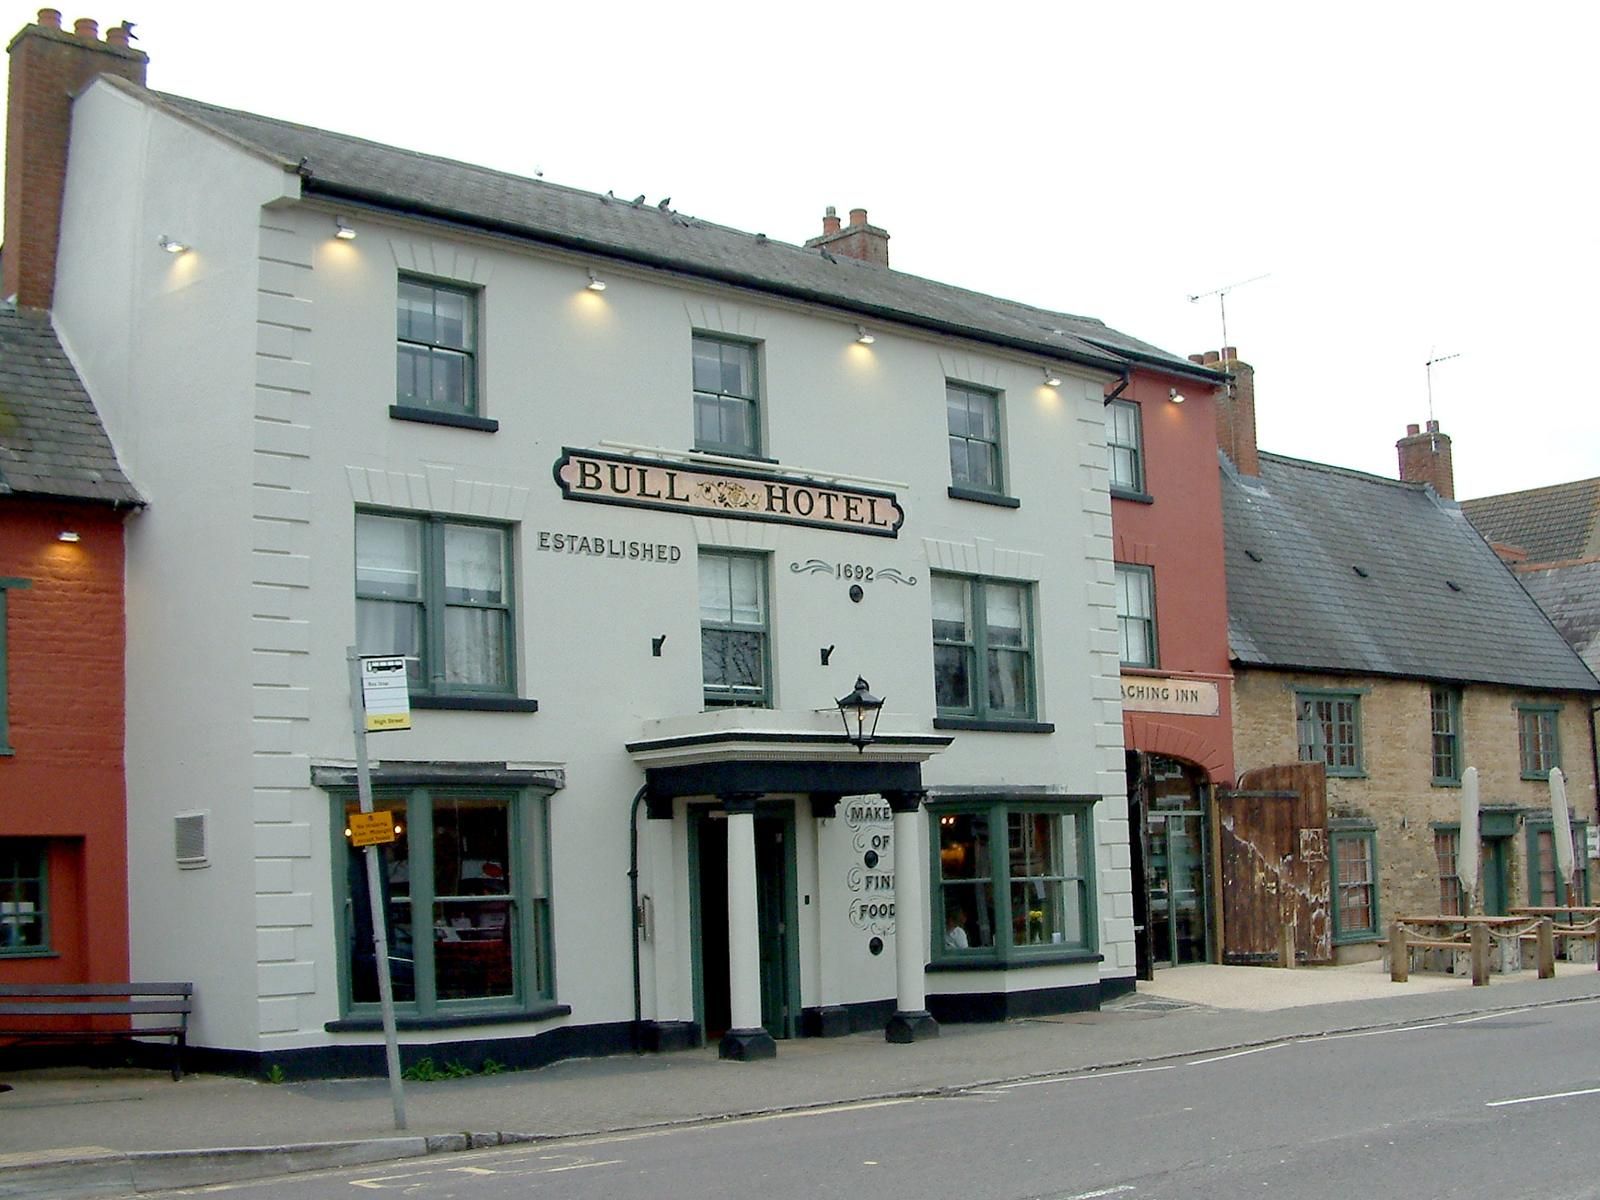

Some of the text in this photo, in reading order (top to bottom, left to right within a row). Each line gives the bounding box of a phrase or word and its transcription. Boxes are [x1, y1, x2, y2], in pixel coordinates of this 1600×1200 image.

[575, 459, 889, 528] BULL HOTEL
[537, 531, 682, 563] ESTABLISHED
[835, 562, 875, 581] 1692
[1175, 688, 1199, 703] INN
[871, 835, 891, 849] OF
